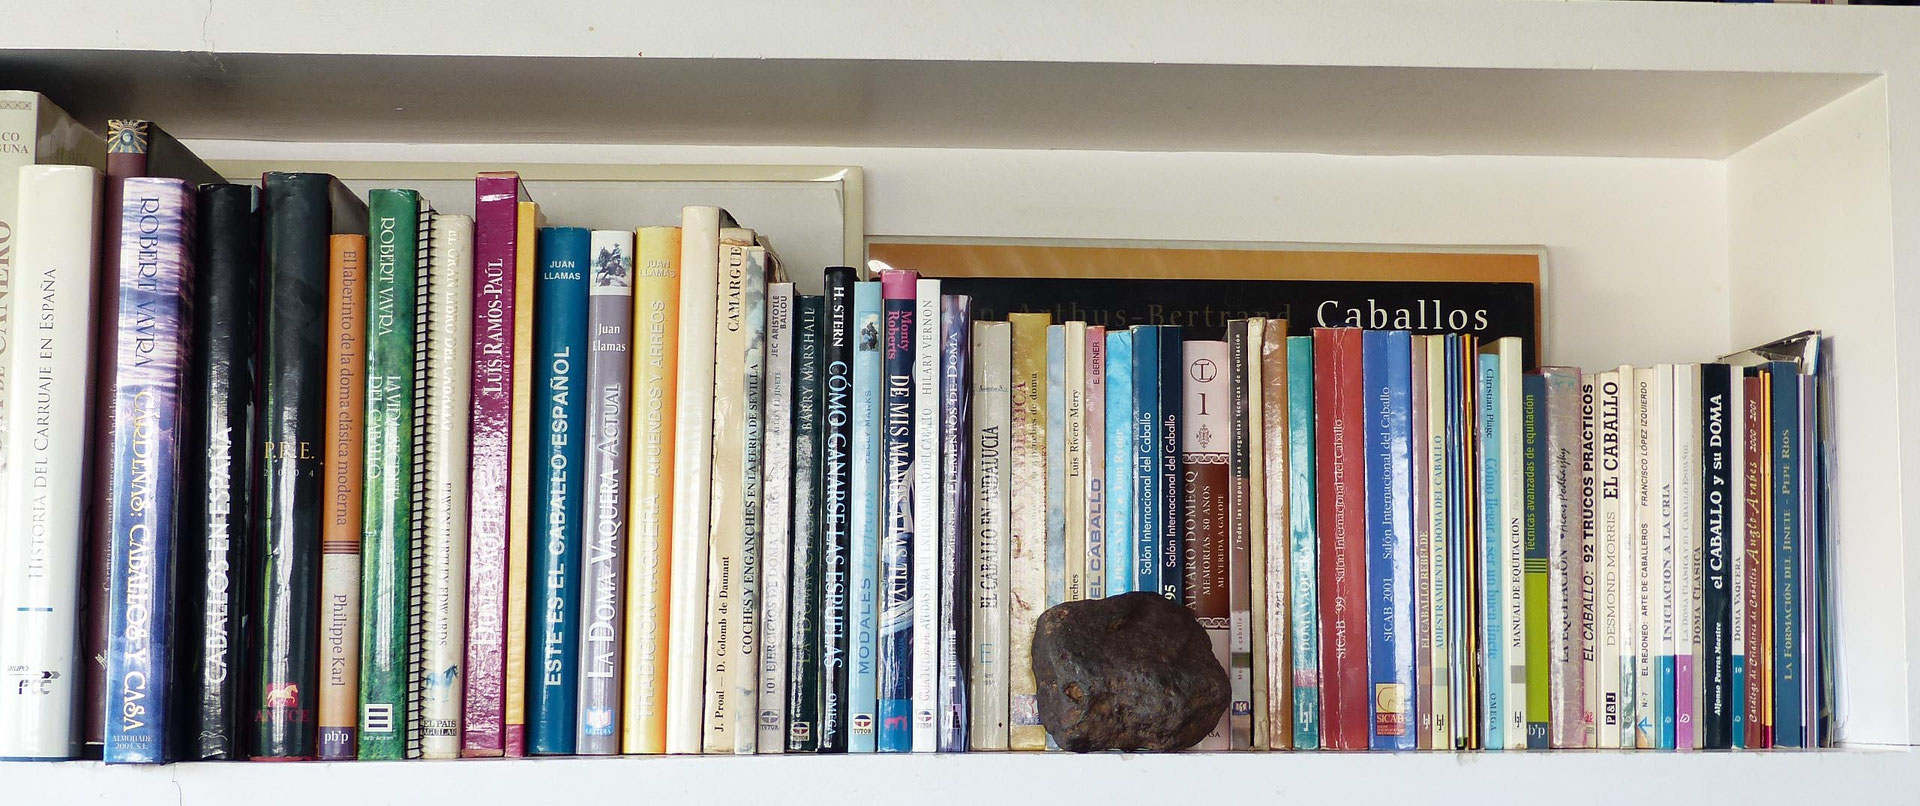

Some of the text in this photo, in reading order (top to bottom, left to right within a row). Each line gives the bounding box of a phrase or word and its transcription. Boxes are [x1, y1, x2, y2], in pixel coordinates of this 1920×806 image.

[134, 196, 160, 367] ROBERT VAVRA
[378, 216, 395, 337] ROBERT VAVRA
[544, 272, 581, 280] LLAMAS
[550, 260, 575, 268] JUAN
[728, 246, 743, 333] CAMARGUE
[780, 295, 788, 330] BALLOU
[482, 258, 504, 396] LUIS RAMOS-PAÚL
[592, 340, 627, 353] Llamas
[598, 324, 621, 336] Juan
[771, 295, 780, 358] JEC ARISTOTLE
[832, 286, 845, 348] H. STERN
[887, 310, 900, 360] Roberts
[899, 310, 913, 352] Monty
[922, 300, 933, 395] HILARY VERNON
[1092, 341, 1100, 385] E. BERNER
[1317, 299, 1488, 330] Caballos
[336, 250, 357, 526] El laberinto de la doma clásica moderna
[802, 308, 816, 431] BARRY MARSHALL
[945, 332, 959, 494] ELEMENTOS DE DOMA
[1484, 368, 1495, 439] Christian Plage
[28, 268, 57, 578] HISTORIA DEL CARRUAJE EN ESPAÑA
[1069, 389, 1081, 477] Luis Rivero Merry
[1433, 435, 1442, 486] CABALLO
[1603, 381, 1618, 500] EL CABALLO
[1639, 381, 1649, 507] FRANCISCO LÓPEZ IZQUIERDO
[546, 346, 570, 686] ESTE ES EL CABALLO ESPAÑOL
[742, 363, 759, 655] COCHES Y ENGANCHES EN LA FERIA DE SEVILLA
[823, 360, 852, 669] CÓMO GANARSE LAS ESPUELAS
[1140, 412, 1152, 575] Salón Internacional del Caballo
[1164, 414, 1177, 601] 95 Salón Internacional del Caballo
[1333, 419, 1345, 583] Salón Internacional del Caballo
[1380, 386, 1393, 642] SICAB 2001 Salón Internacional del Caballo
[1434, 487, 1442, 509] DEL
[1484, 498, 1498, 533] llegar
[1485, 458, 1498, 494] Cómo
[1523, 394, 1536, 552] Técnicas avanzadas de equitación
[1710, 394, 1725, 589] el CABALLO y su DOMA
[122, 390, 159, 732] CÁRDENAS: CABALLOS Y CASA
[206, 427, 232, 684] CABALLOS EN ESPAÑA
[587, 383, 622, 678] LA DOMA VAQUERA ACTUAL
[1090, 478, 1102, 599] EL CABALLO
[1186, 470, 1199, 611] ALVARO DOMECQ
[1201, 485, 1211, 596] MEMORIAS. 80 AÑOS
[1434, 511, 1443, 543] DOMA
[1486, 546, 1496, 566] ser
[1582, 383, 1594, 662] EL CABALLO: 92 TRUCOS PRACTICOS
[1661, 483, 1672, 642] INICIACION A LA CRIA
[858, 577, 871, 674] MODALES
[1419, 531, 1430, 649] EL CABALLO REBELDE
[1434, 554, 1444, 649] ADIESTRAMIENTO
[1486, 569, 1496, 586] un
[1486, 590, 1499, 622] buen
[1511, 517, 1522, 648] MANUAL DE EQUITACION
[1606, 511, 1616, 647] DESMOND MORRIS
[1641, 581, 1648, 592] DE
[1733, 556, 1742, 642] DOMA VAQUERA
[329, 593, 348, 687] Philippe Karl
[714, 556, 730, 733] J. Proal D. Colomb de Daunant
[1485, 624, 1498, 660] jinete
[1641, 622, 1649, 664] REJONEO:
[1642, 667, 1649, 677] EL
